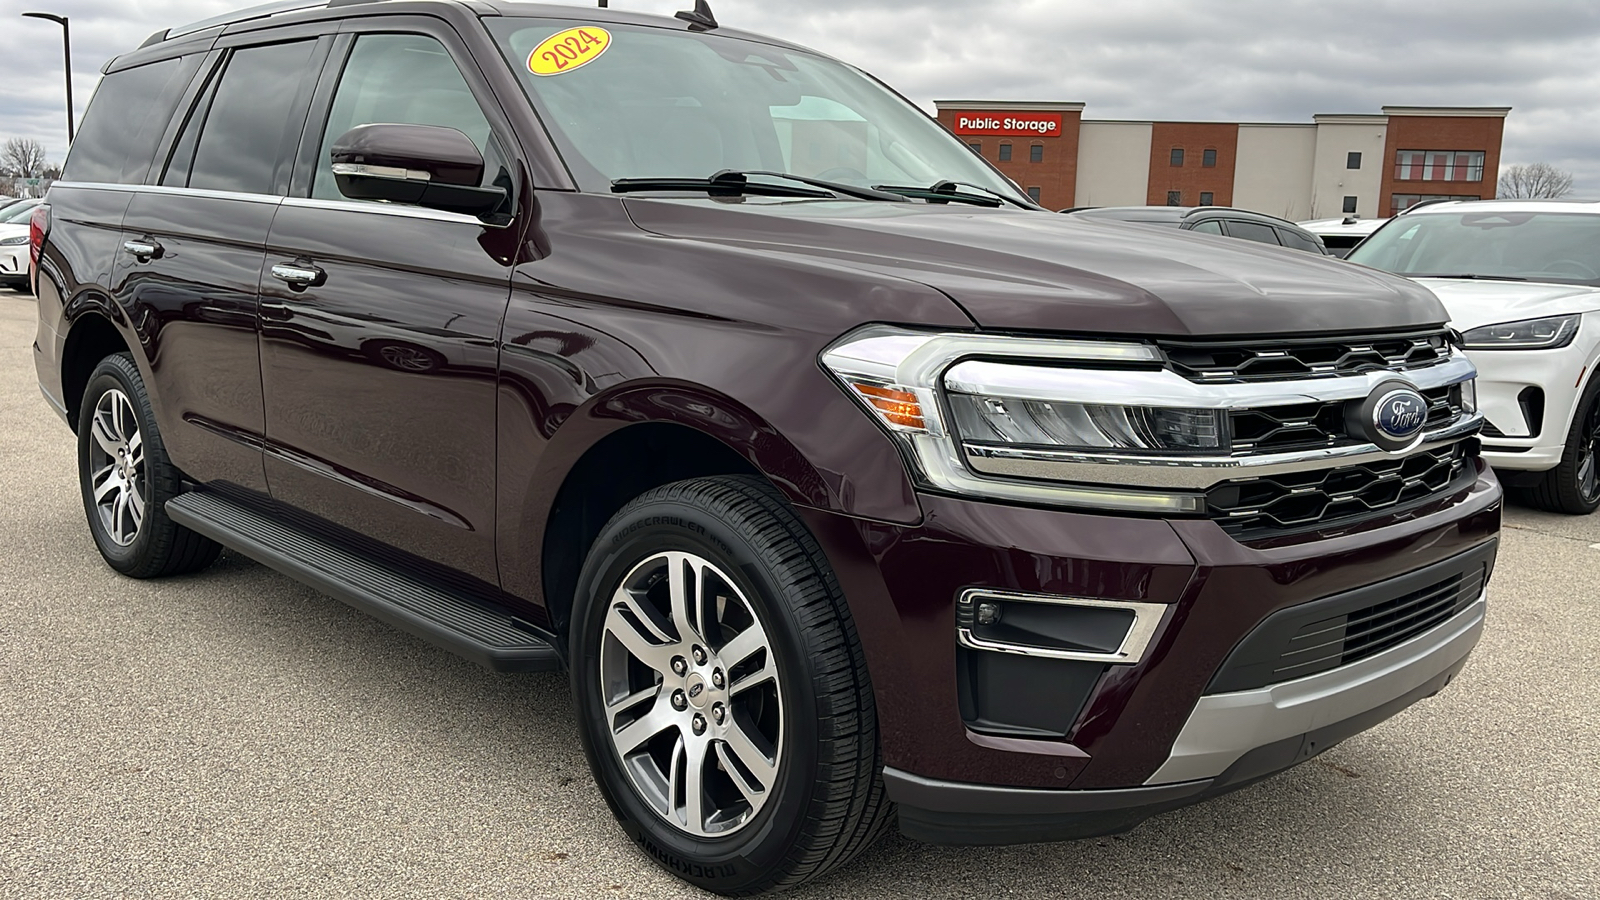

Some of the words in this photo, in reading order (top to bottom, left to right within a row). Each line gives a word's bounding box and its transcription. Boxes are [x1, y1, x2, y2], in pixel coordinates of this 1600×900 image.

[542, 29, 602, 69] 2024
[959, 117, 1000, 130] Public
[1003, 118, 1056, 133] Storage
[1391, 400, 1421, 430] Ford
[611, 516, 705, 545] RIDGECRAWLER
[636, 832, 737, 880] BLACKHAWK
